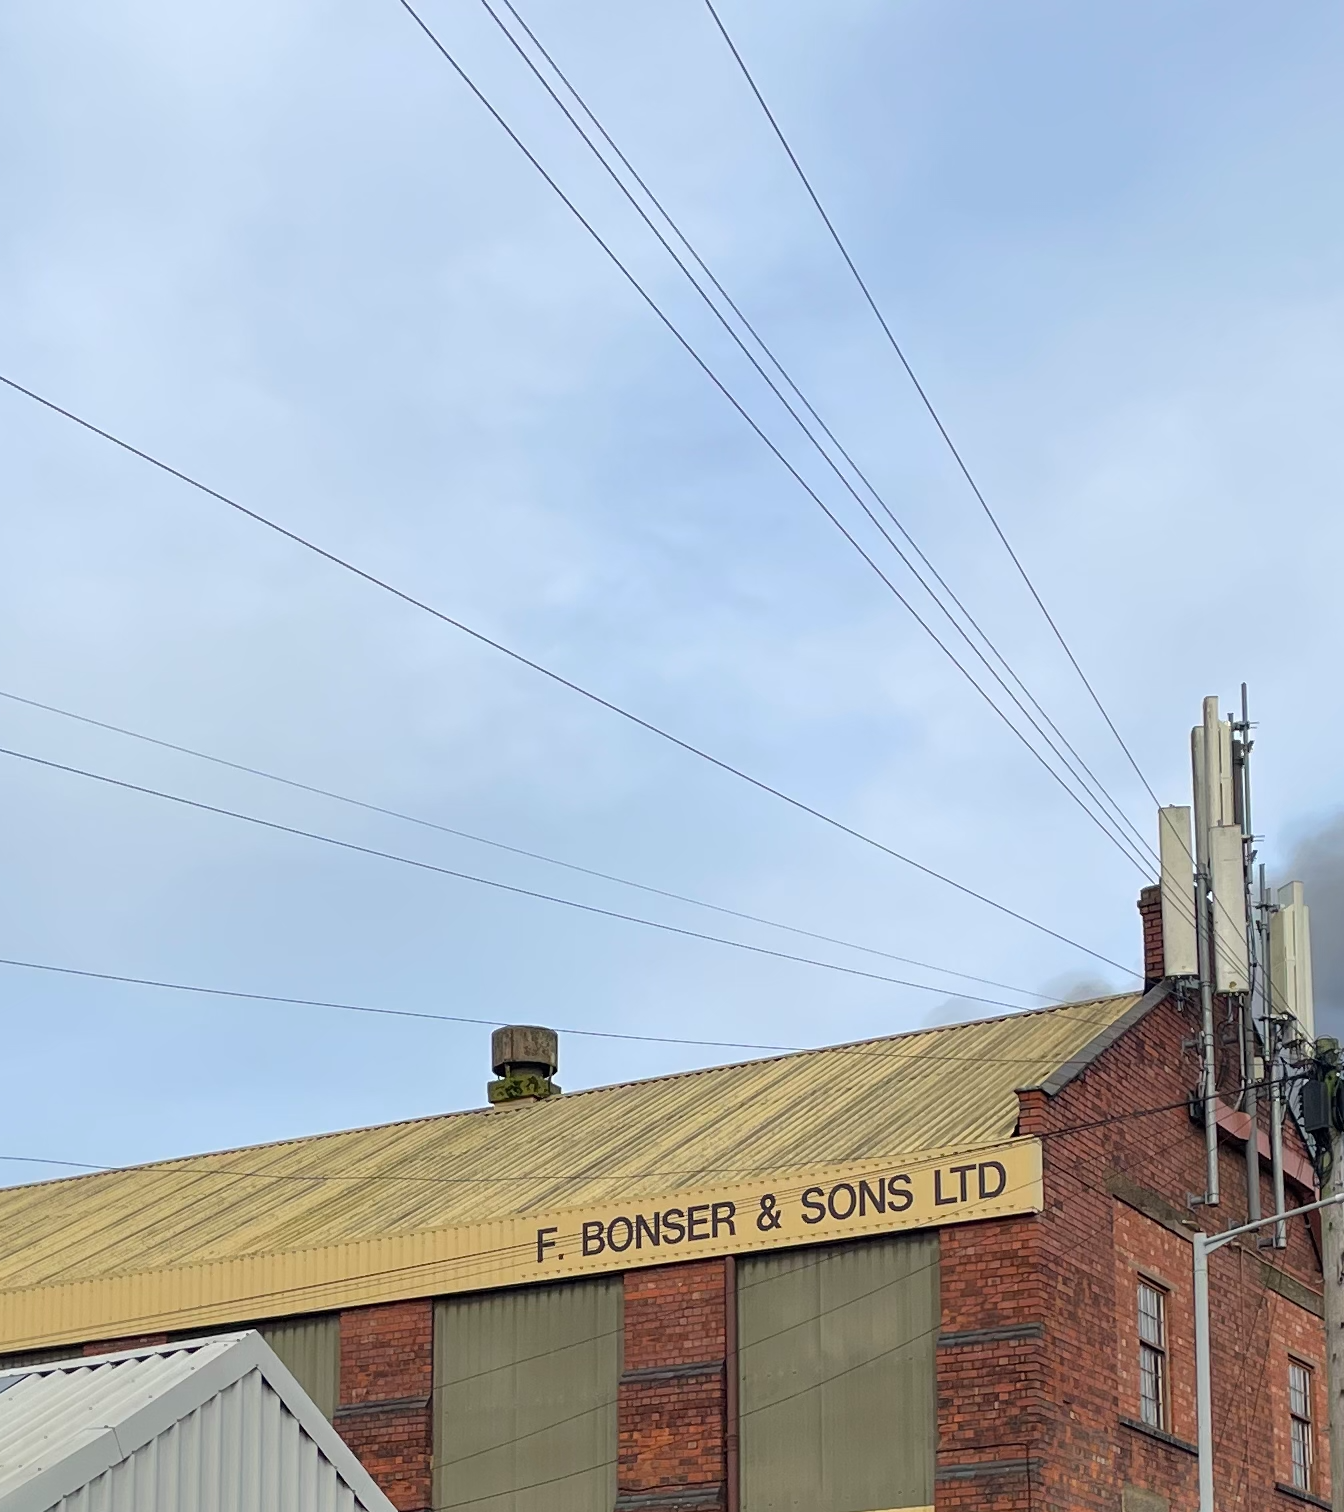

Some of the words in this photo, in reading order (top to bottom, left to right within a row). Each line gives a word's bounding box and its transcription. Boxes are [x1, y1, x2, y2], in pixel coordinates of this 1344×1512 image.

[537, 1227, 564, 1263] F.
[582, 1201, 736, 1256] BONSER
[756, 1193, 782, 1232] &
[801, 1174, 913, 1224] SONS
[934, 1160, 1007, 1206] LTD
